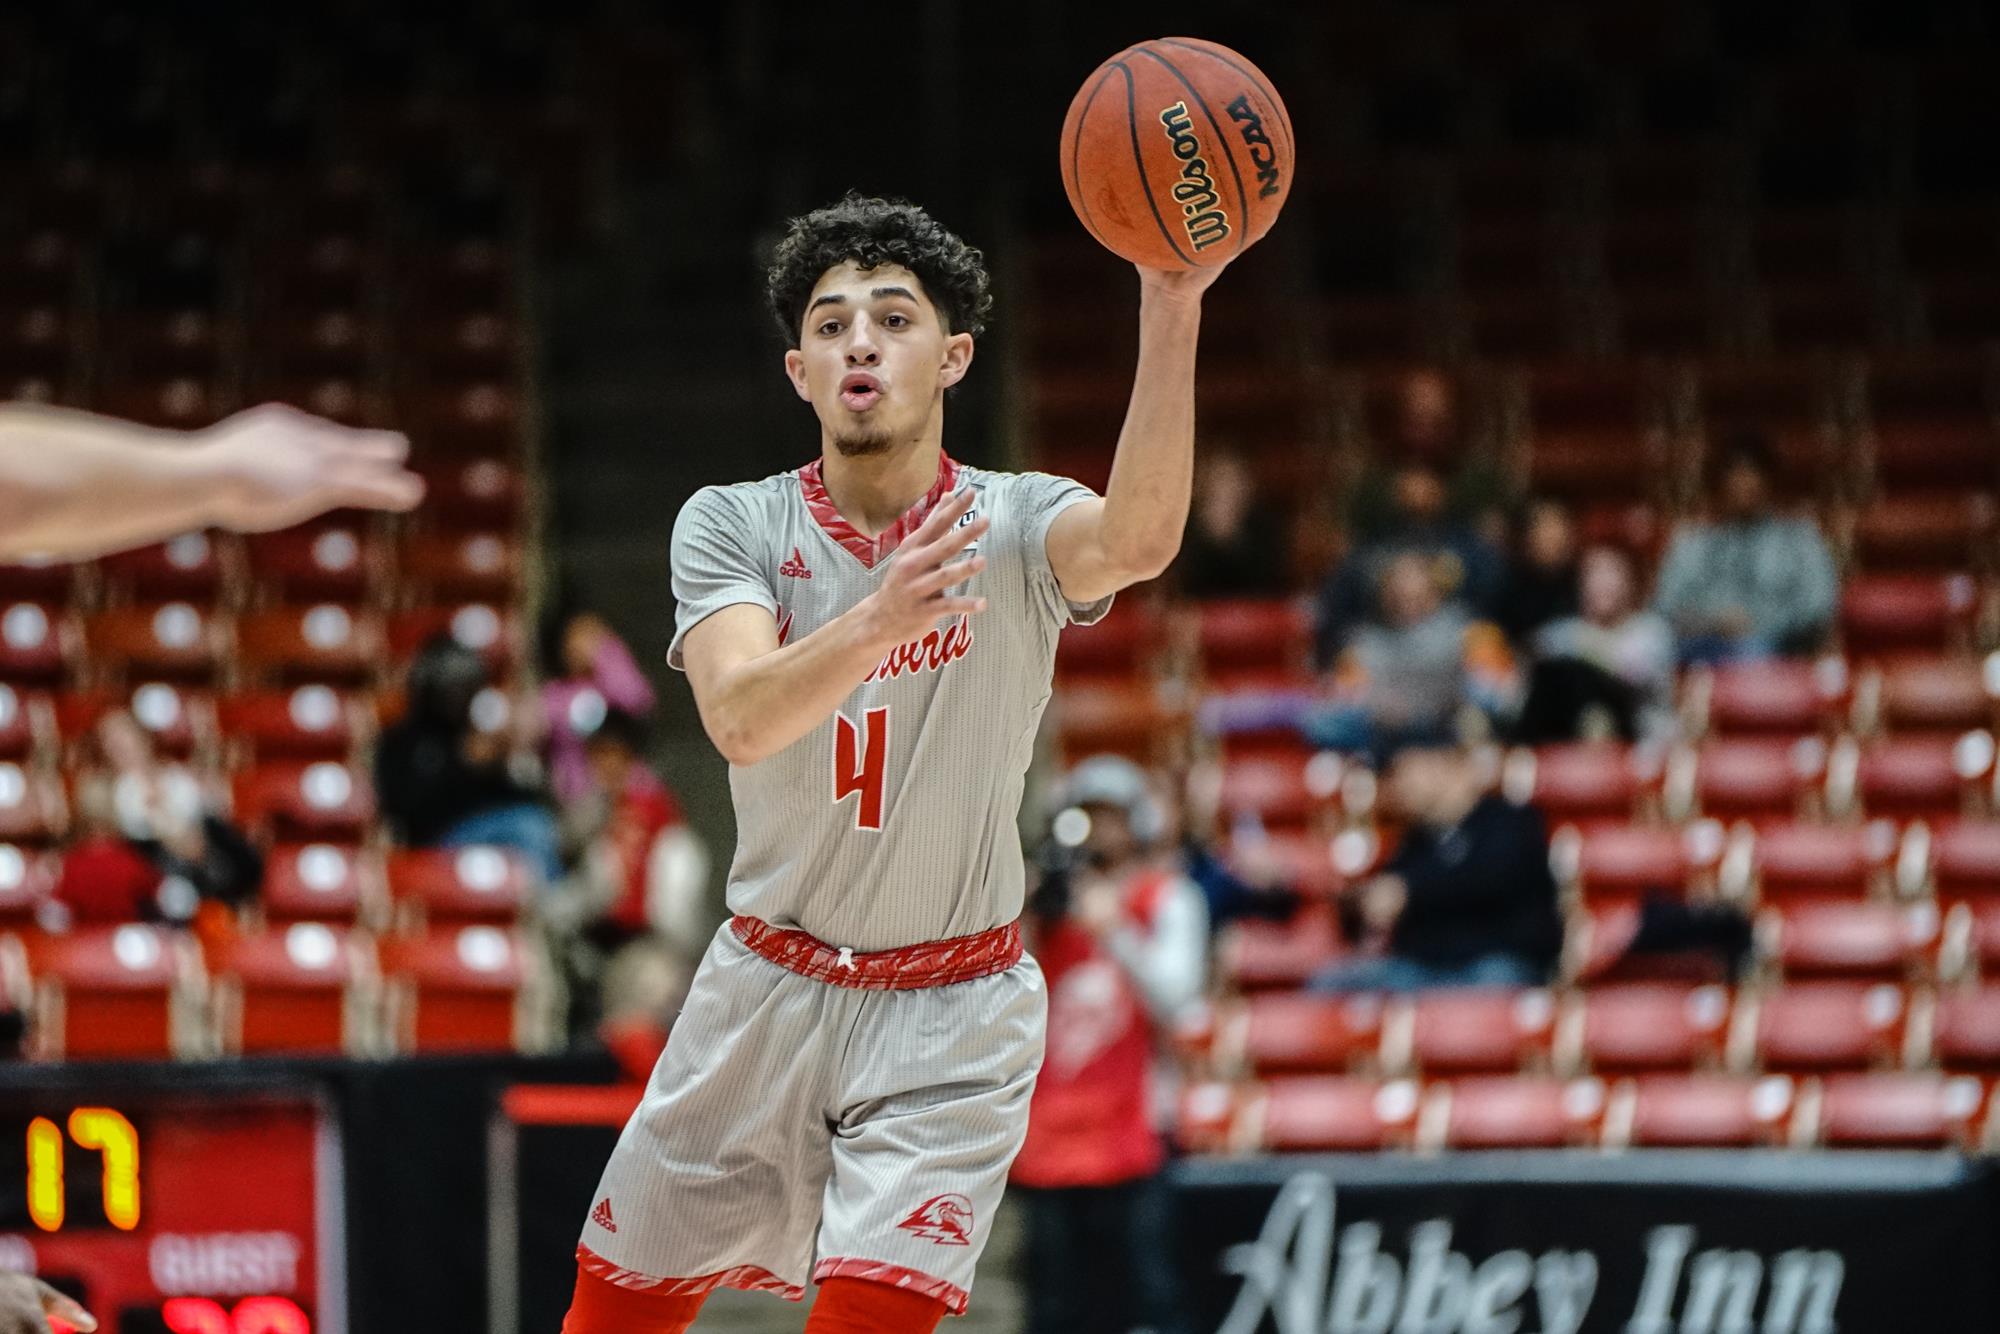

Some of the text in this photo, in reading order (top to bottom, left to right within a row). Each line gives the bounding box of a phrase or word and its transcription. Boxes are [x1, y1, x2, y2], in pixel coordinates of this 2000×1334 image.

[1159, 101, 1231, 253] Wilson
[1226, 96, 1280, 200] NCAA
[780, 566, 812, 579] addas
[834, 706, 888, 830] 4
[27, 1107, 139, 1232] 17
[1218, 1172, 1845, 1334] Abbey Inn
